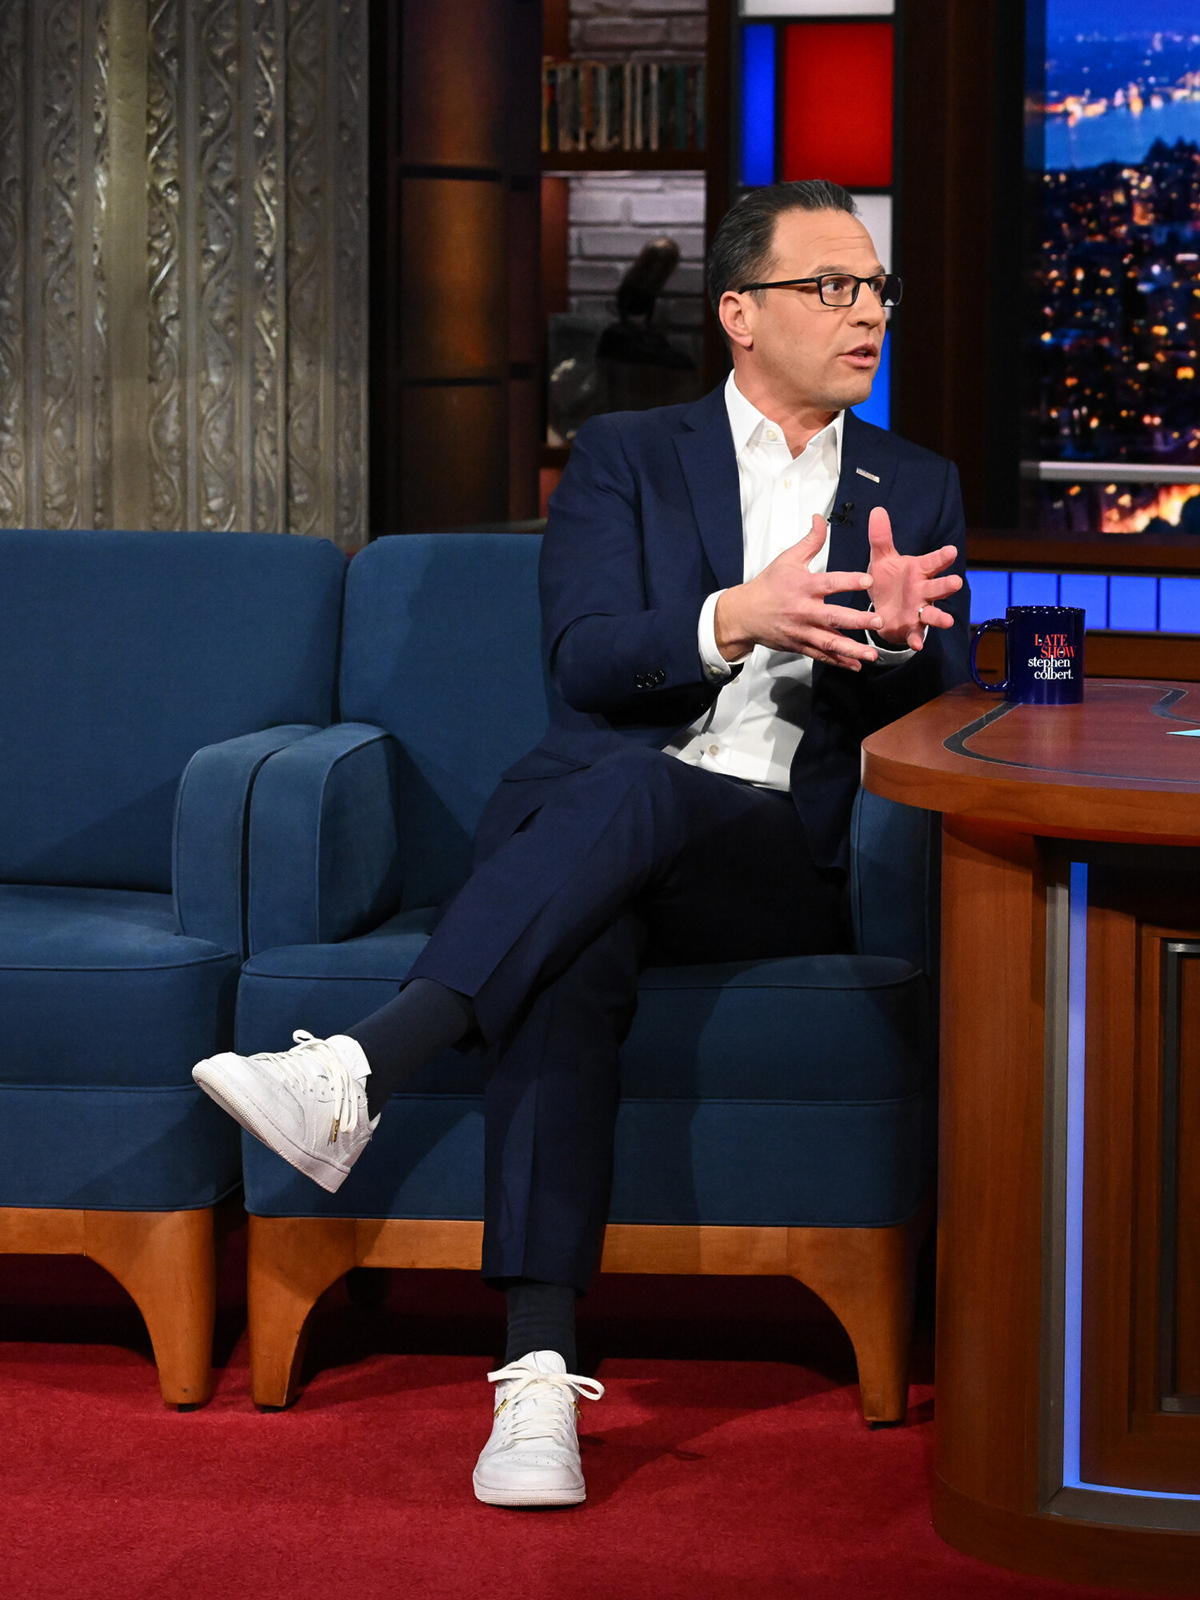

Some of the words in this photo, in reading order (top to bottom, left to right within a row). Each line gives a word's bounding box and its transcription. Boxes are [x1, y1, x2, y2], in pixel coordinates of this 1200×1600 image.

[1034, 633, 1068, 646] LATE
[1040, 645, 1077, 659] SHOW
[1028, 655, 1070, 671] stephen
[1034, 667, 1074, 680] colbert.
